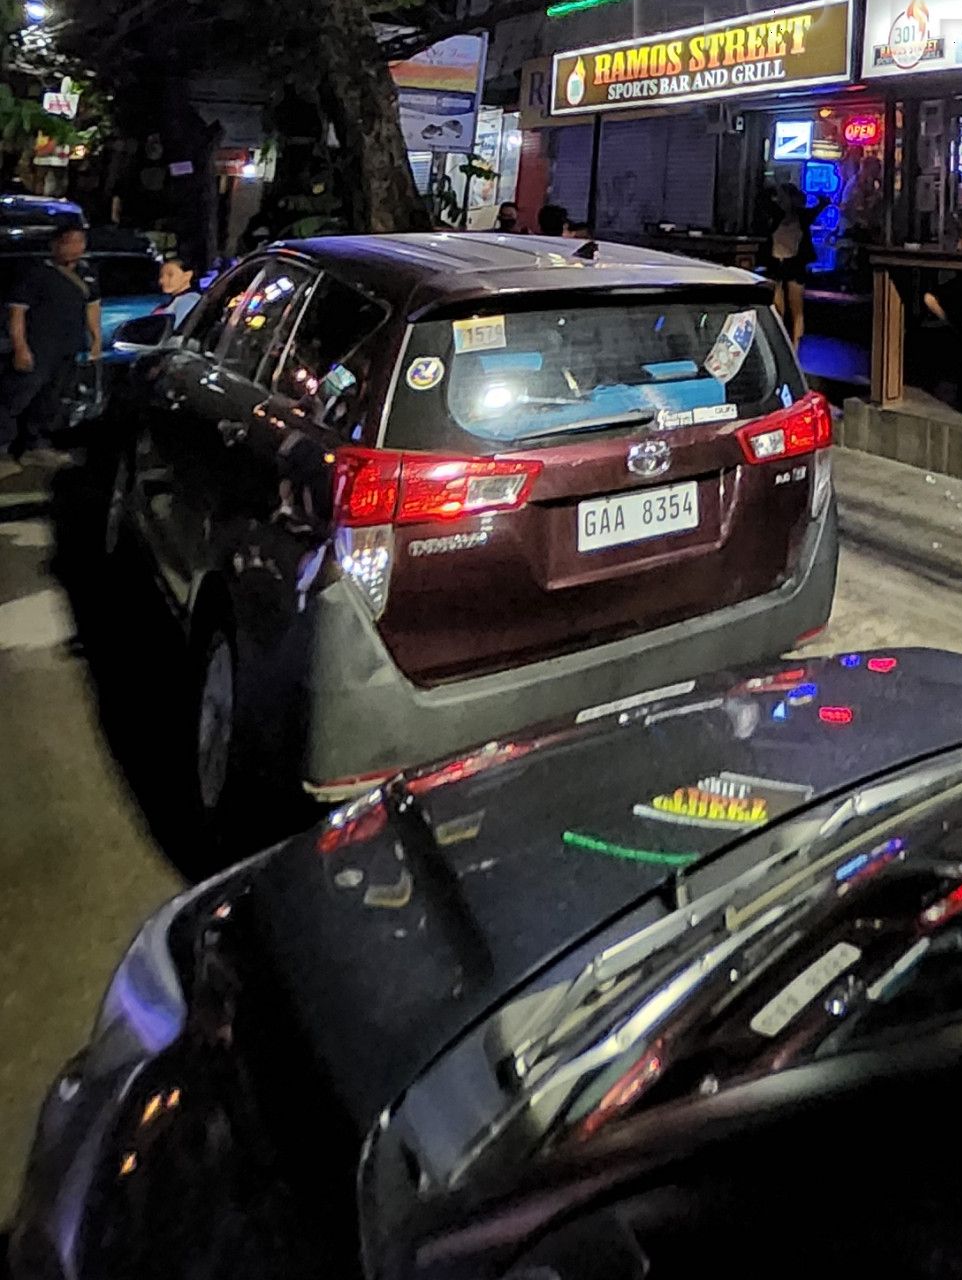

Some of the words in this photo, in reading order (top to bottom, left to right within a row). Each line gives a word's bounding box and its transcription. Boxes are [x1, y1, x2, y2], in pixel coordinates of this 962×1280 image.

[593, 40, 684, 86] RAMOS
[689, 14, 813, 74] STREET
[893, 24, 917, 44] 301
[608, 79, 659, 101] SPORTS
[659, 74, 691, 96] BAR
[692, 67, 729, 91] AND
[731, 61, 786, 85] GRILL
[844, 121, 877, 142] OPEN
[585, 504, 626, 537] GAA
[642, 492, 693, 525] 8354
